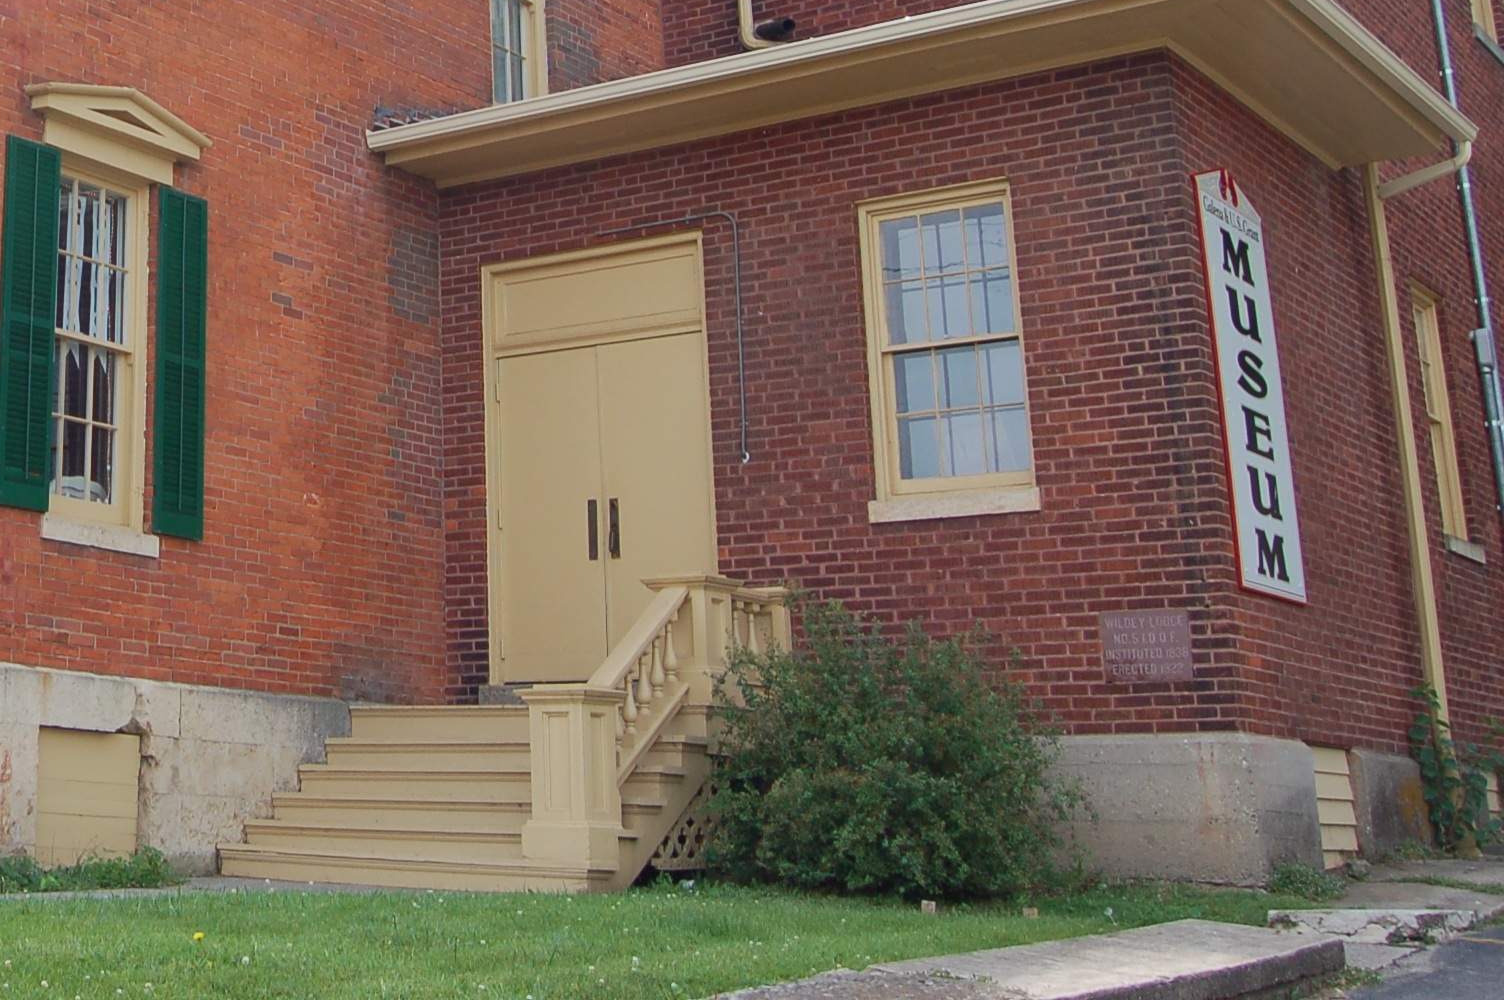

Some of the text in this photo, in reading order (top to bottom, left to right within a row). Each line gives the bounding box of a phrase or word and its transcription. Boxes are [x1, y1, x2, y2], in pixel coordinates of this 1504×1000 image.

[1220, 226, 1290, 583] MUSEUM
[1104, 648, 1163, 660] INSTITUTED
[1112, 663, 1158, 676] ERECTED
